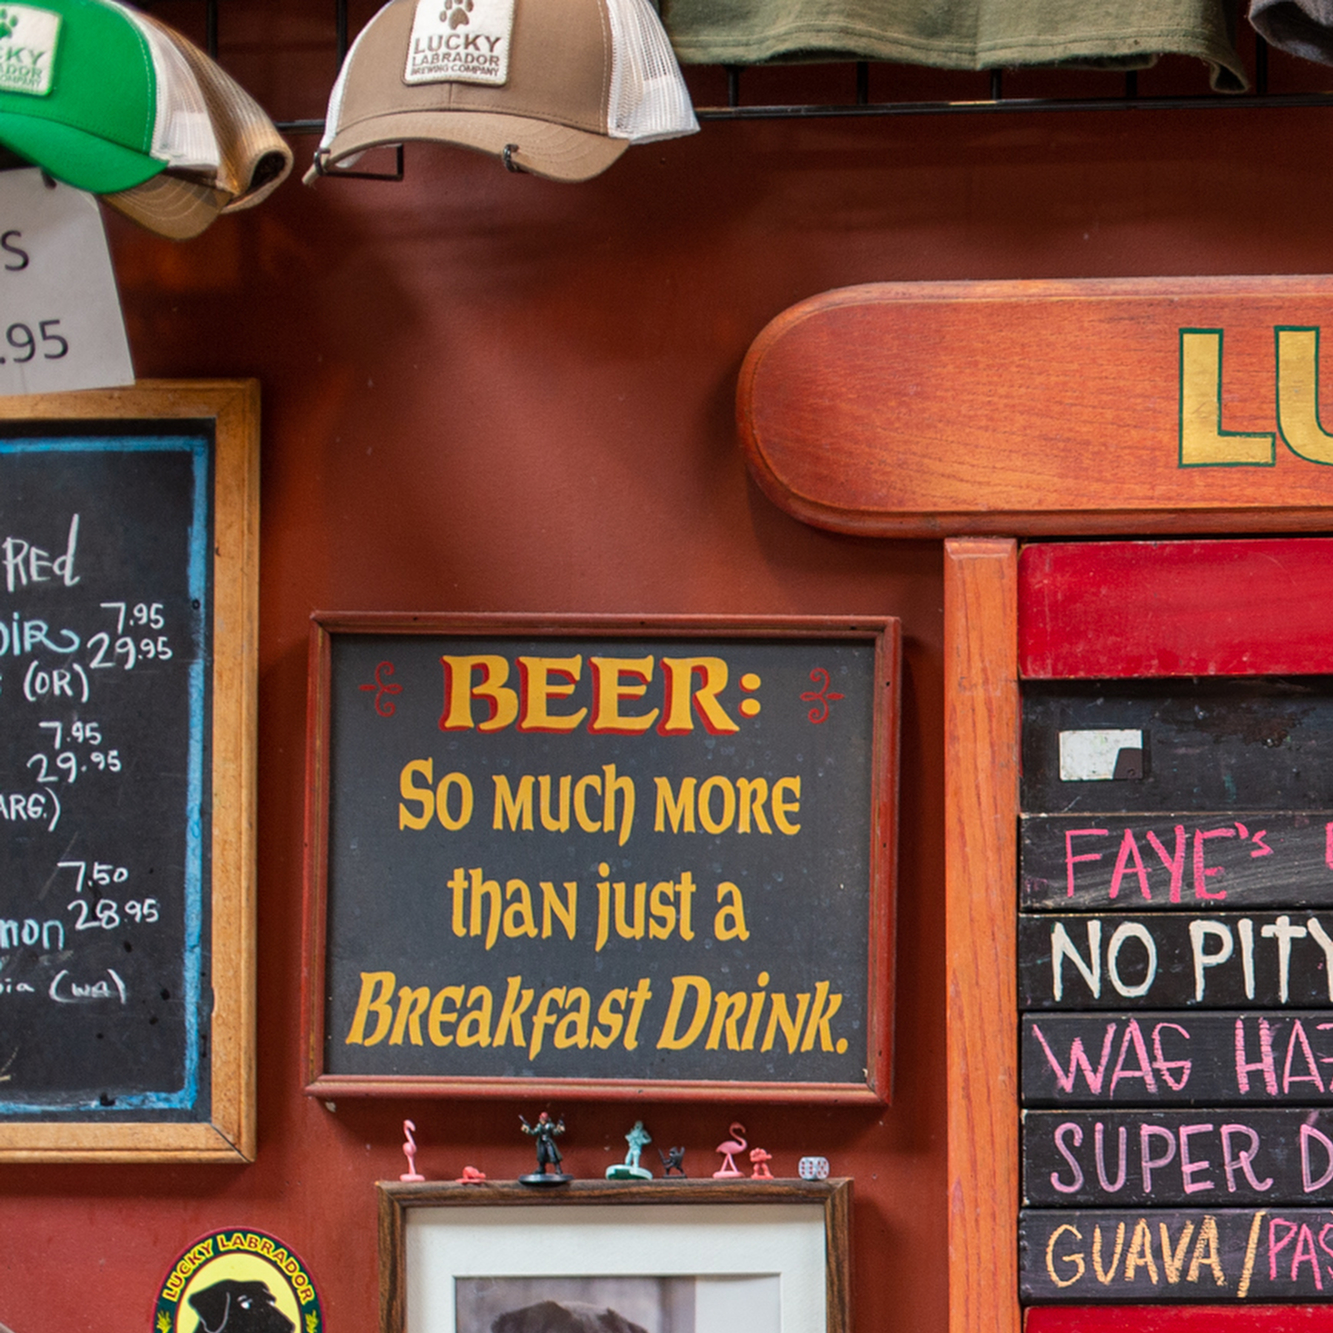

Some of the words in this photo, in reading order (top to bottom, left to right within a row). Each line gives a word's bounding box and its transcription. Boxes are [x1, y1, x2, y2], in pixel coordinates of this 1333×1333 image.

[411, 52, 500, 67] LABRADOR
[414, 33, 501, 54] LUCKY
[410, 64, 449, 76] BREWING
[451, 64, 500, 77] COMPANY
[100, 602, 165, 635] 7.95
[87, 631, 173, 670] 29.95
[23, 660, 89, 702] (OR)
[439, 654, 762, 736] BEER:
[38, 721, 102, 750] 7.95
[26, 750, 122, 783] 29.95
[399, 758, 474, 832] So
[57, 861, 128, 892] 7.50
[67, 899, 159, 930] 28.95
[447, 867, 577, 950] than
[595, 862, 696, 951] just
[714, 881, 750, 941] a
[1051, 917, 1158, 1000] NO
[346, 971, 651, 1061] Breakfast
[656, 971, 849, 1054] Drink.
[1032, 1017, 1192, 1097] WAG
[1050, 1121, 1274, 1194] SUPER
[162, 1237, 214, 1303] LUCKY
[216, 1231, 316, 1306] LABRADOR
